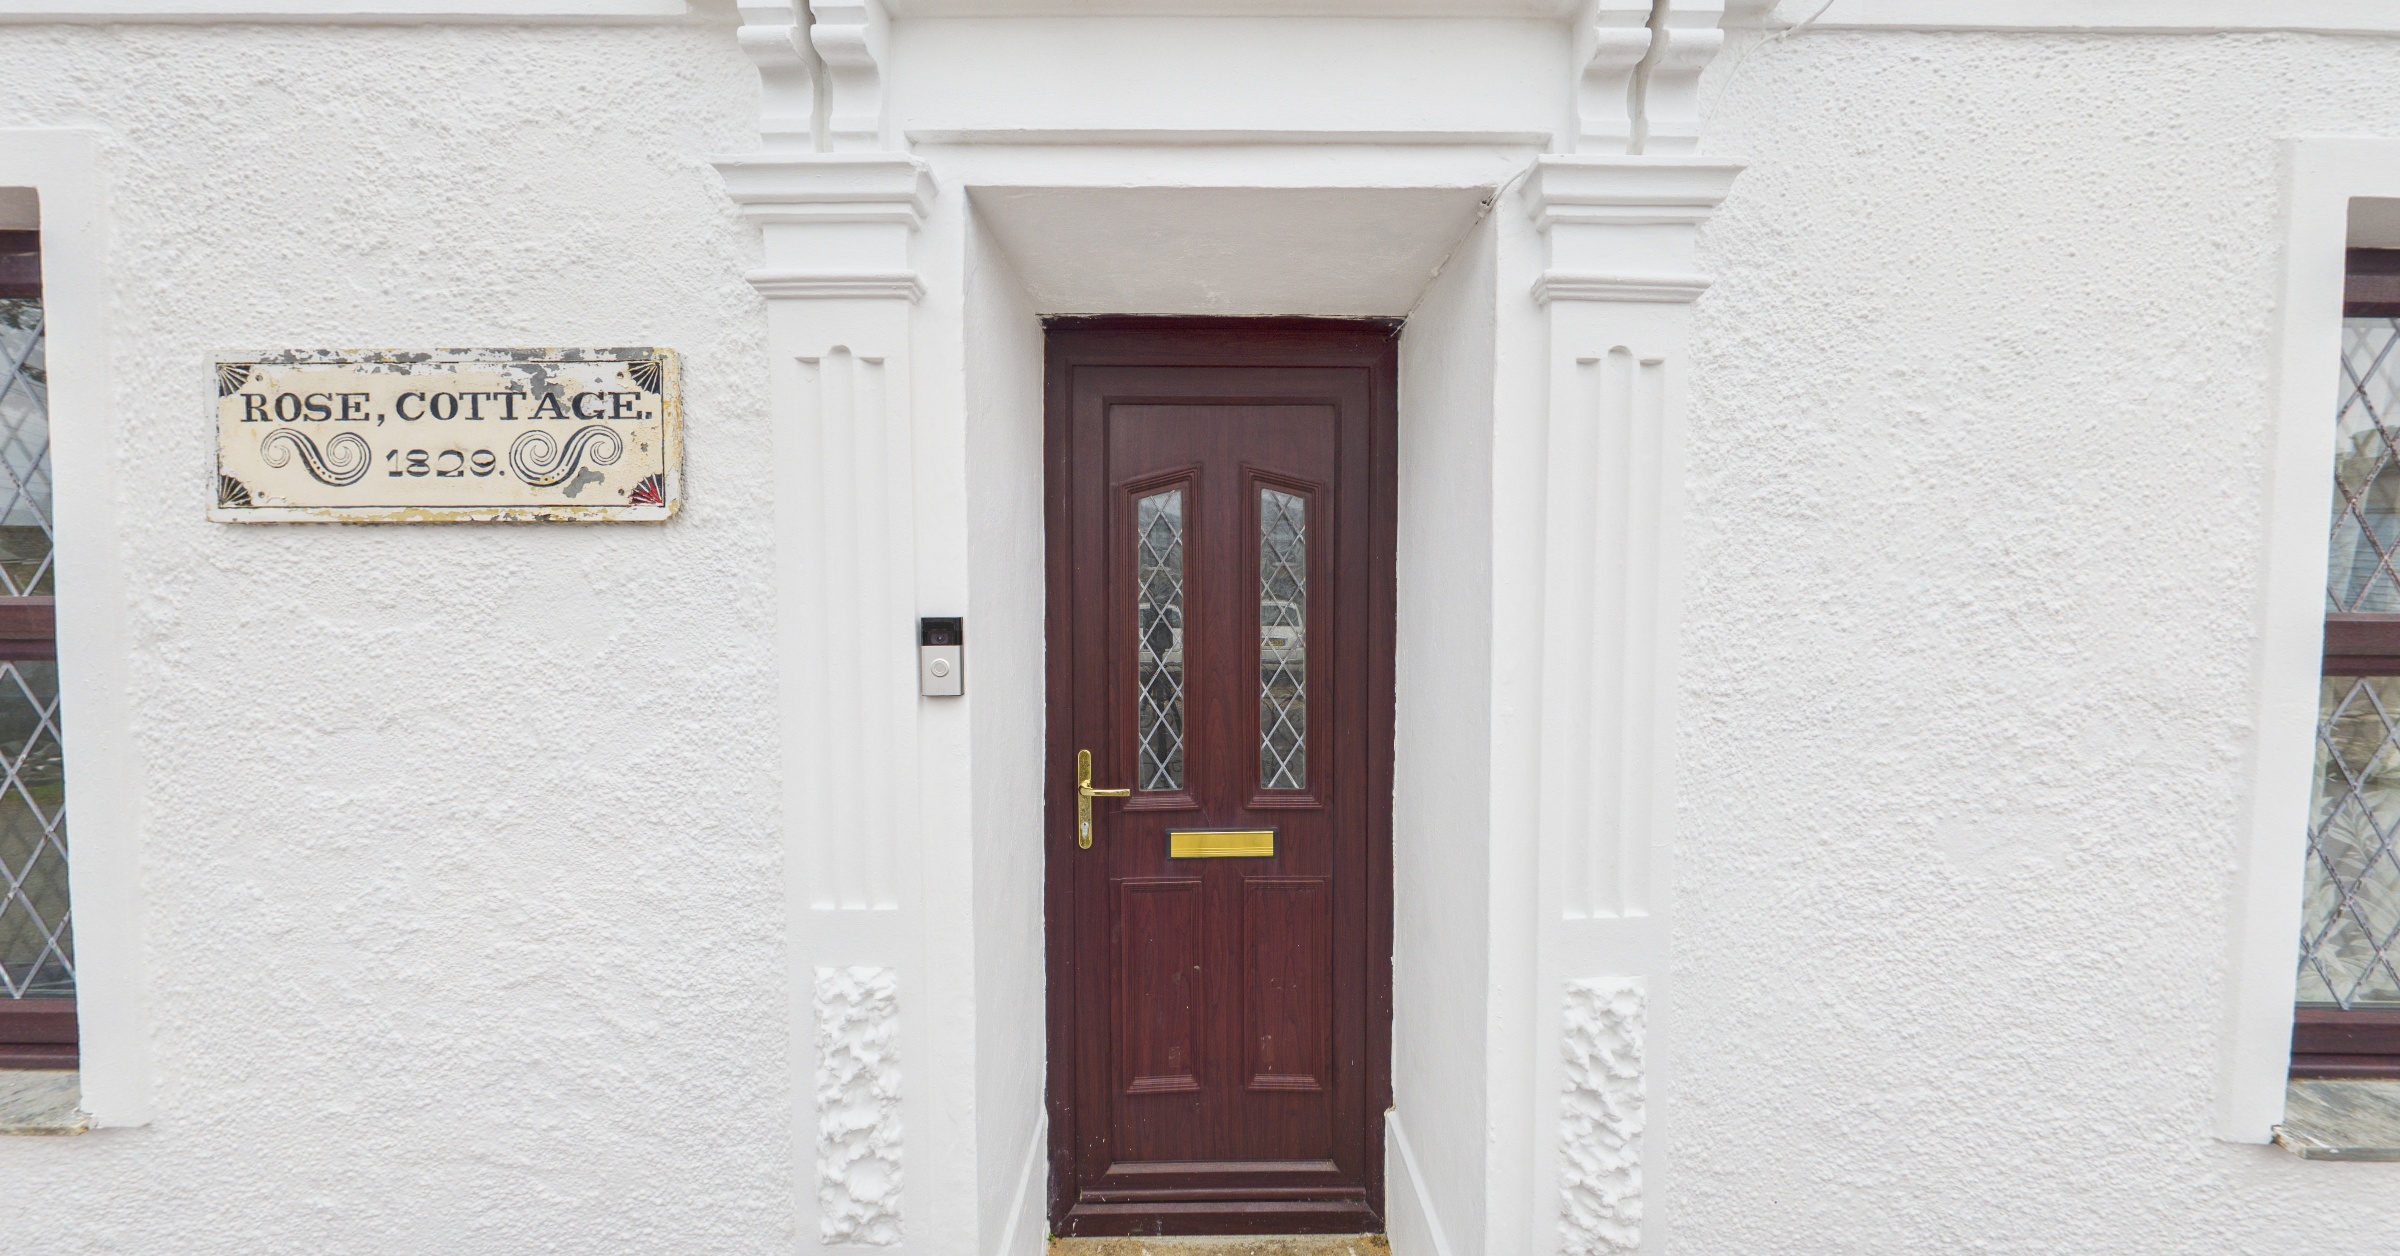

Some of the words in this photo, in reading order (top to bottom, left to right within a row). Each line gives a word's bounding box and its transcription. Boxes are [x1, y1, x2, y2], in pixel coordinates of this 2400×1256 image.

[240, 392, 385, 427] ROSE,
[396, 391, 652, 421] COTTAGE.
[386, 449, 505, 477] 1829.
